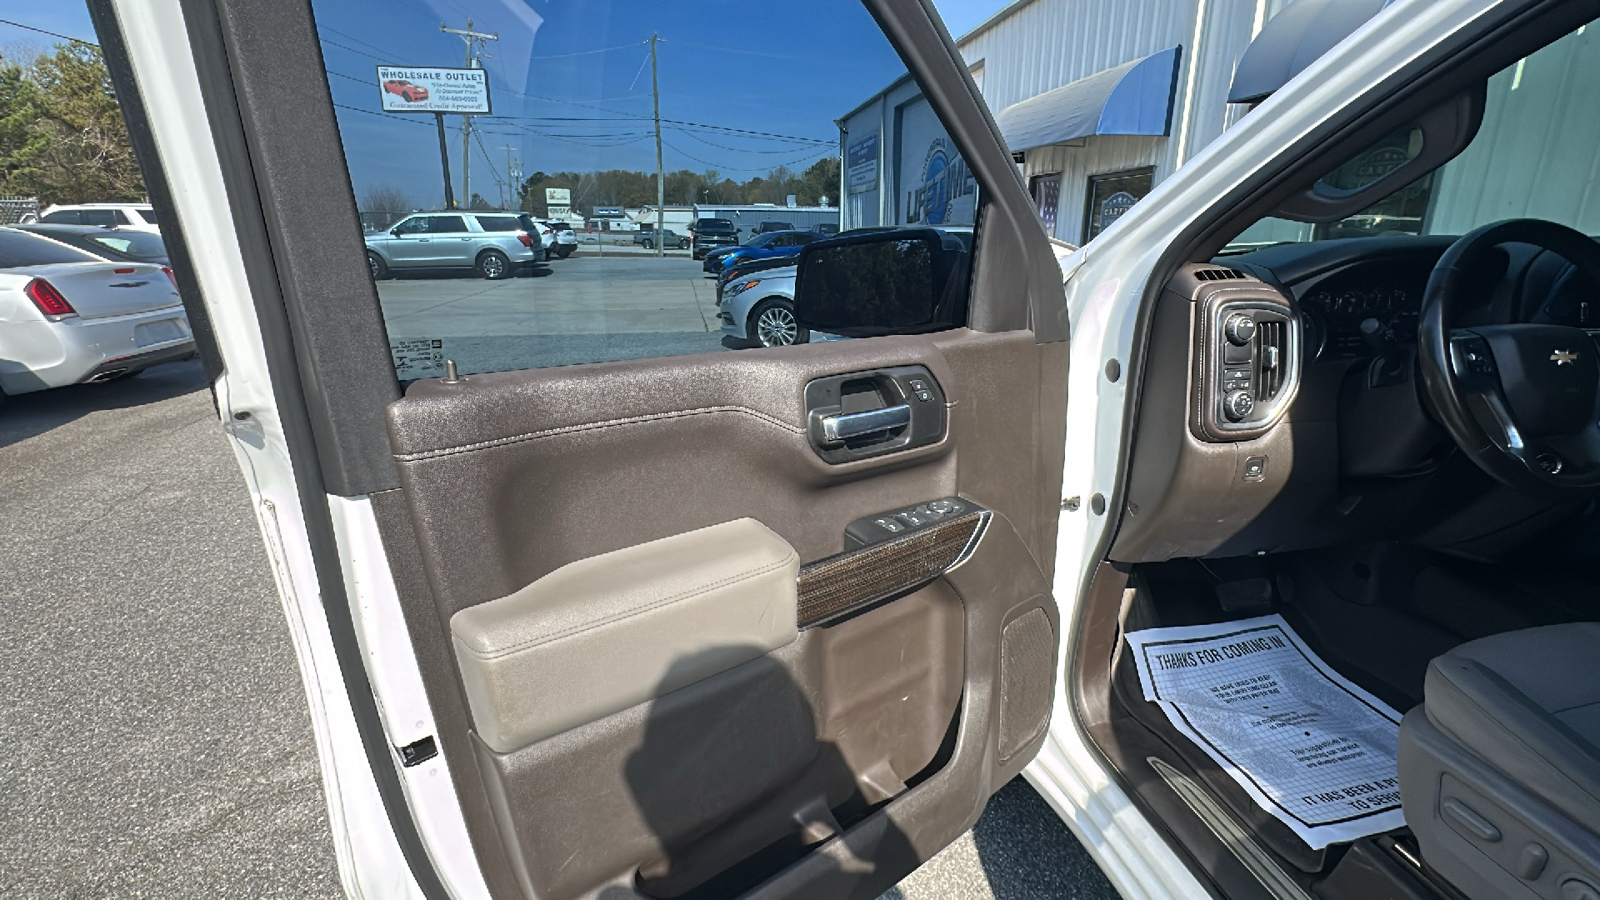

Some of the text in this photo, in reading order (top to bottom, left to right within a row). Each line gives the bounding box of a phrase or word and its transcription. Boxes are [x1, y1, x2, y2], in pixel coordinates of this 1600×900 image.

[381, 71, 483, 81] WHOLESALE OUTLET
[1155, 651, 1198, 670] THANKS
[1196, 648, 1225, 665] FOR
[1221, 637, 1272, 659] COMING
[1289, 748, 1305, 756] Your
[1336, 742, 1360, 752] service
[1316, 757, 1339, 766] always
[1301, 776, 1399, 806] IT HAS BEEN A PL
[1347, 799, 1370, 810] TO
